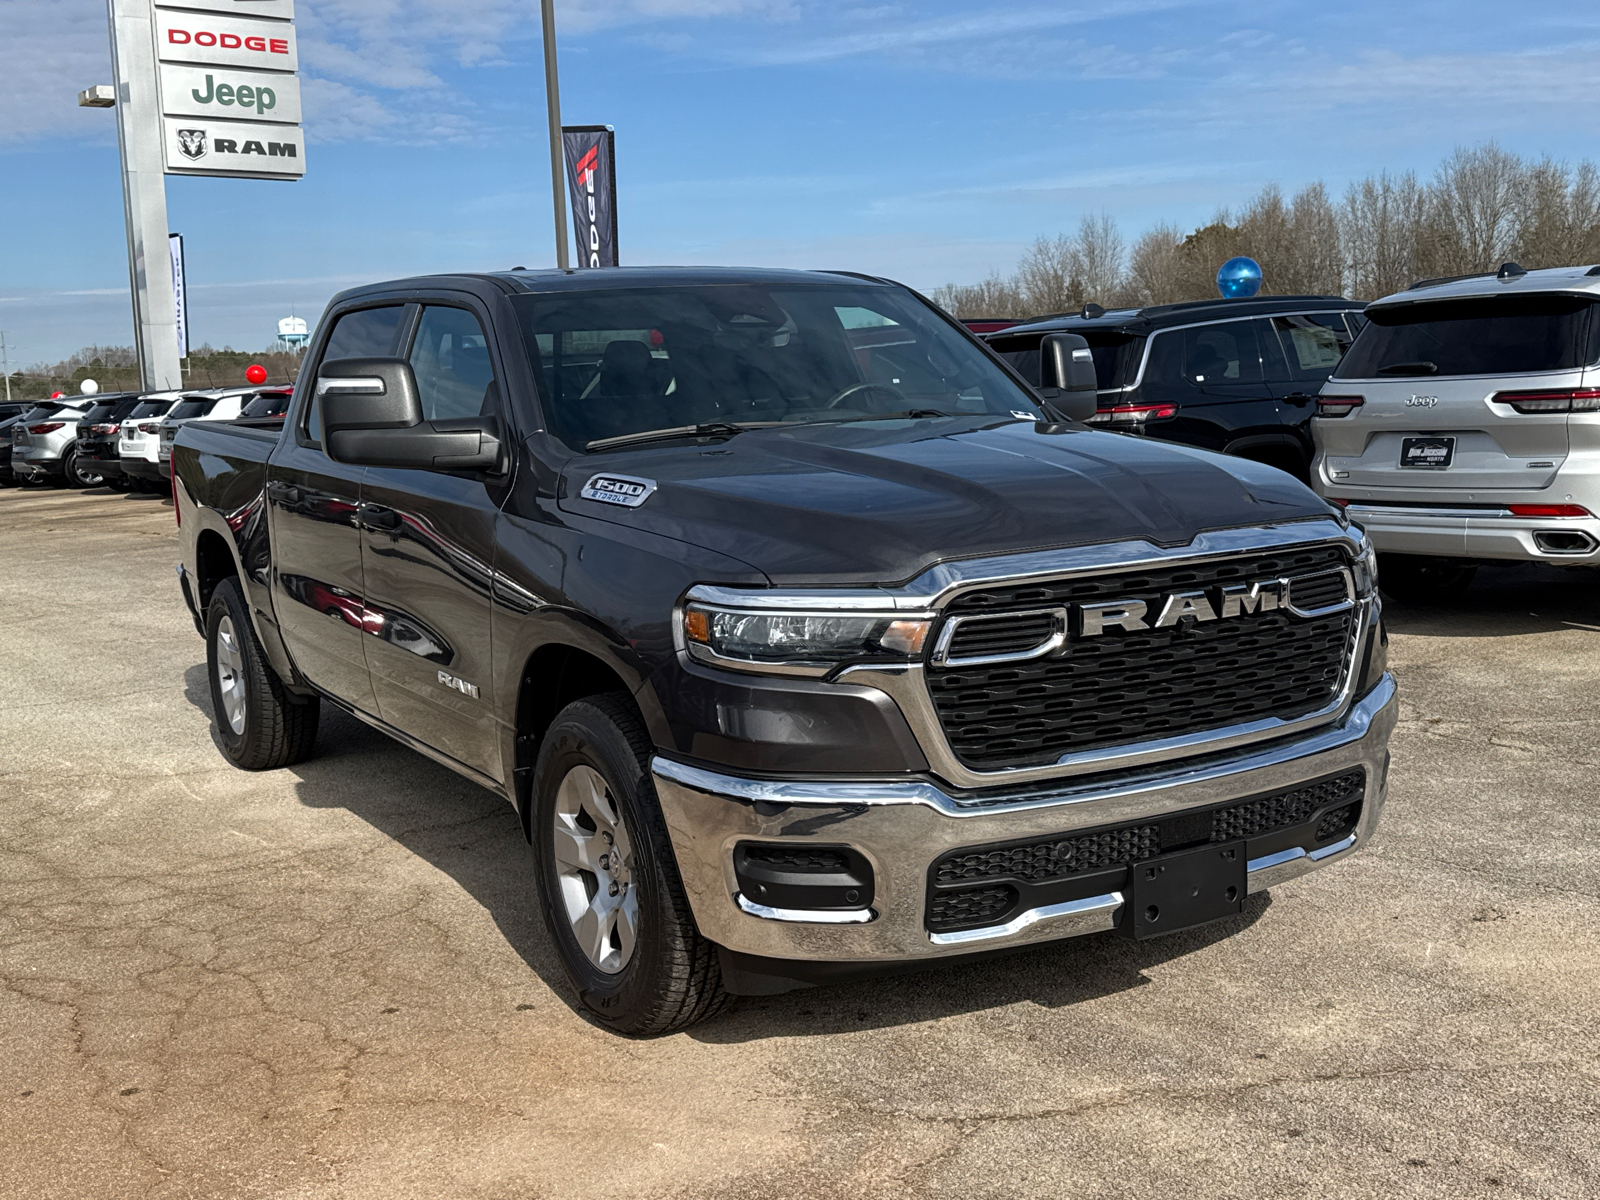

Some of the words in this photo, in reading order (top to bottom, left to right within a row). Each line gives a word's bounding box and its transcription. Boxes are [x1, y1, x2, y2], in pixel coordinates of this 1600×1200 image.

[168, 29, 289, 54] DODGE
[191, 74, 276, 114] Jeep
[214, 138, 297, 157] RAM
[1404, 394, 1438, 408] Jeep
[594, 479, 644, 496] 1500
[1079, 579, 1279, 637] RAM
[437, 670, 481, 699] RAM
